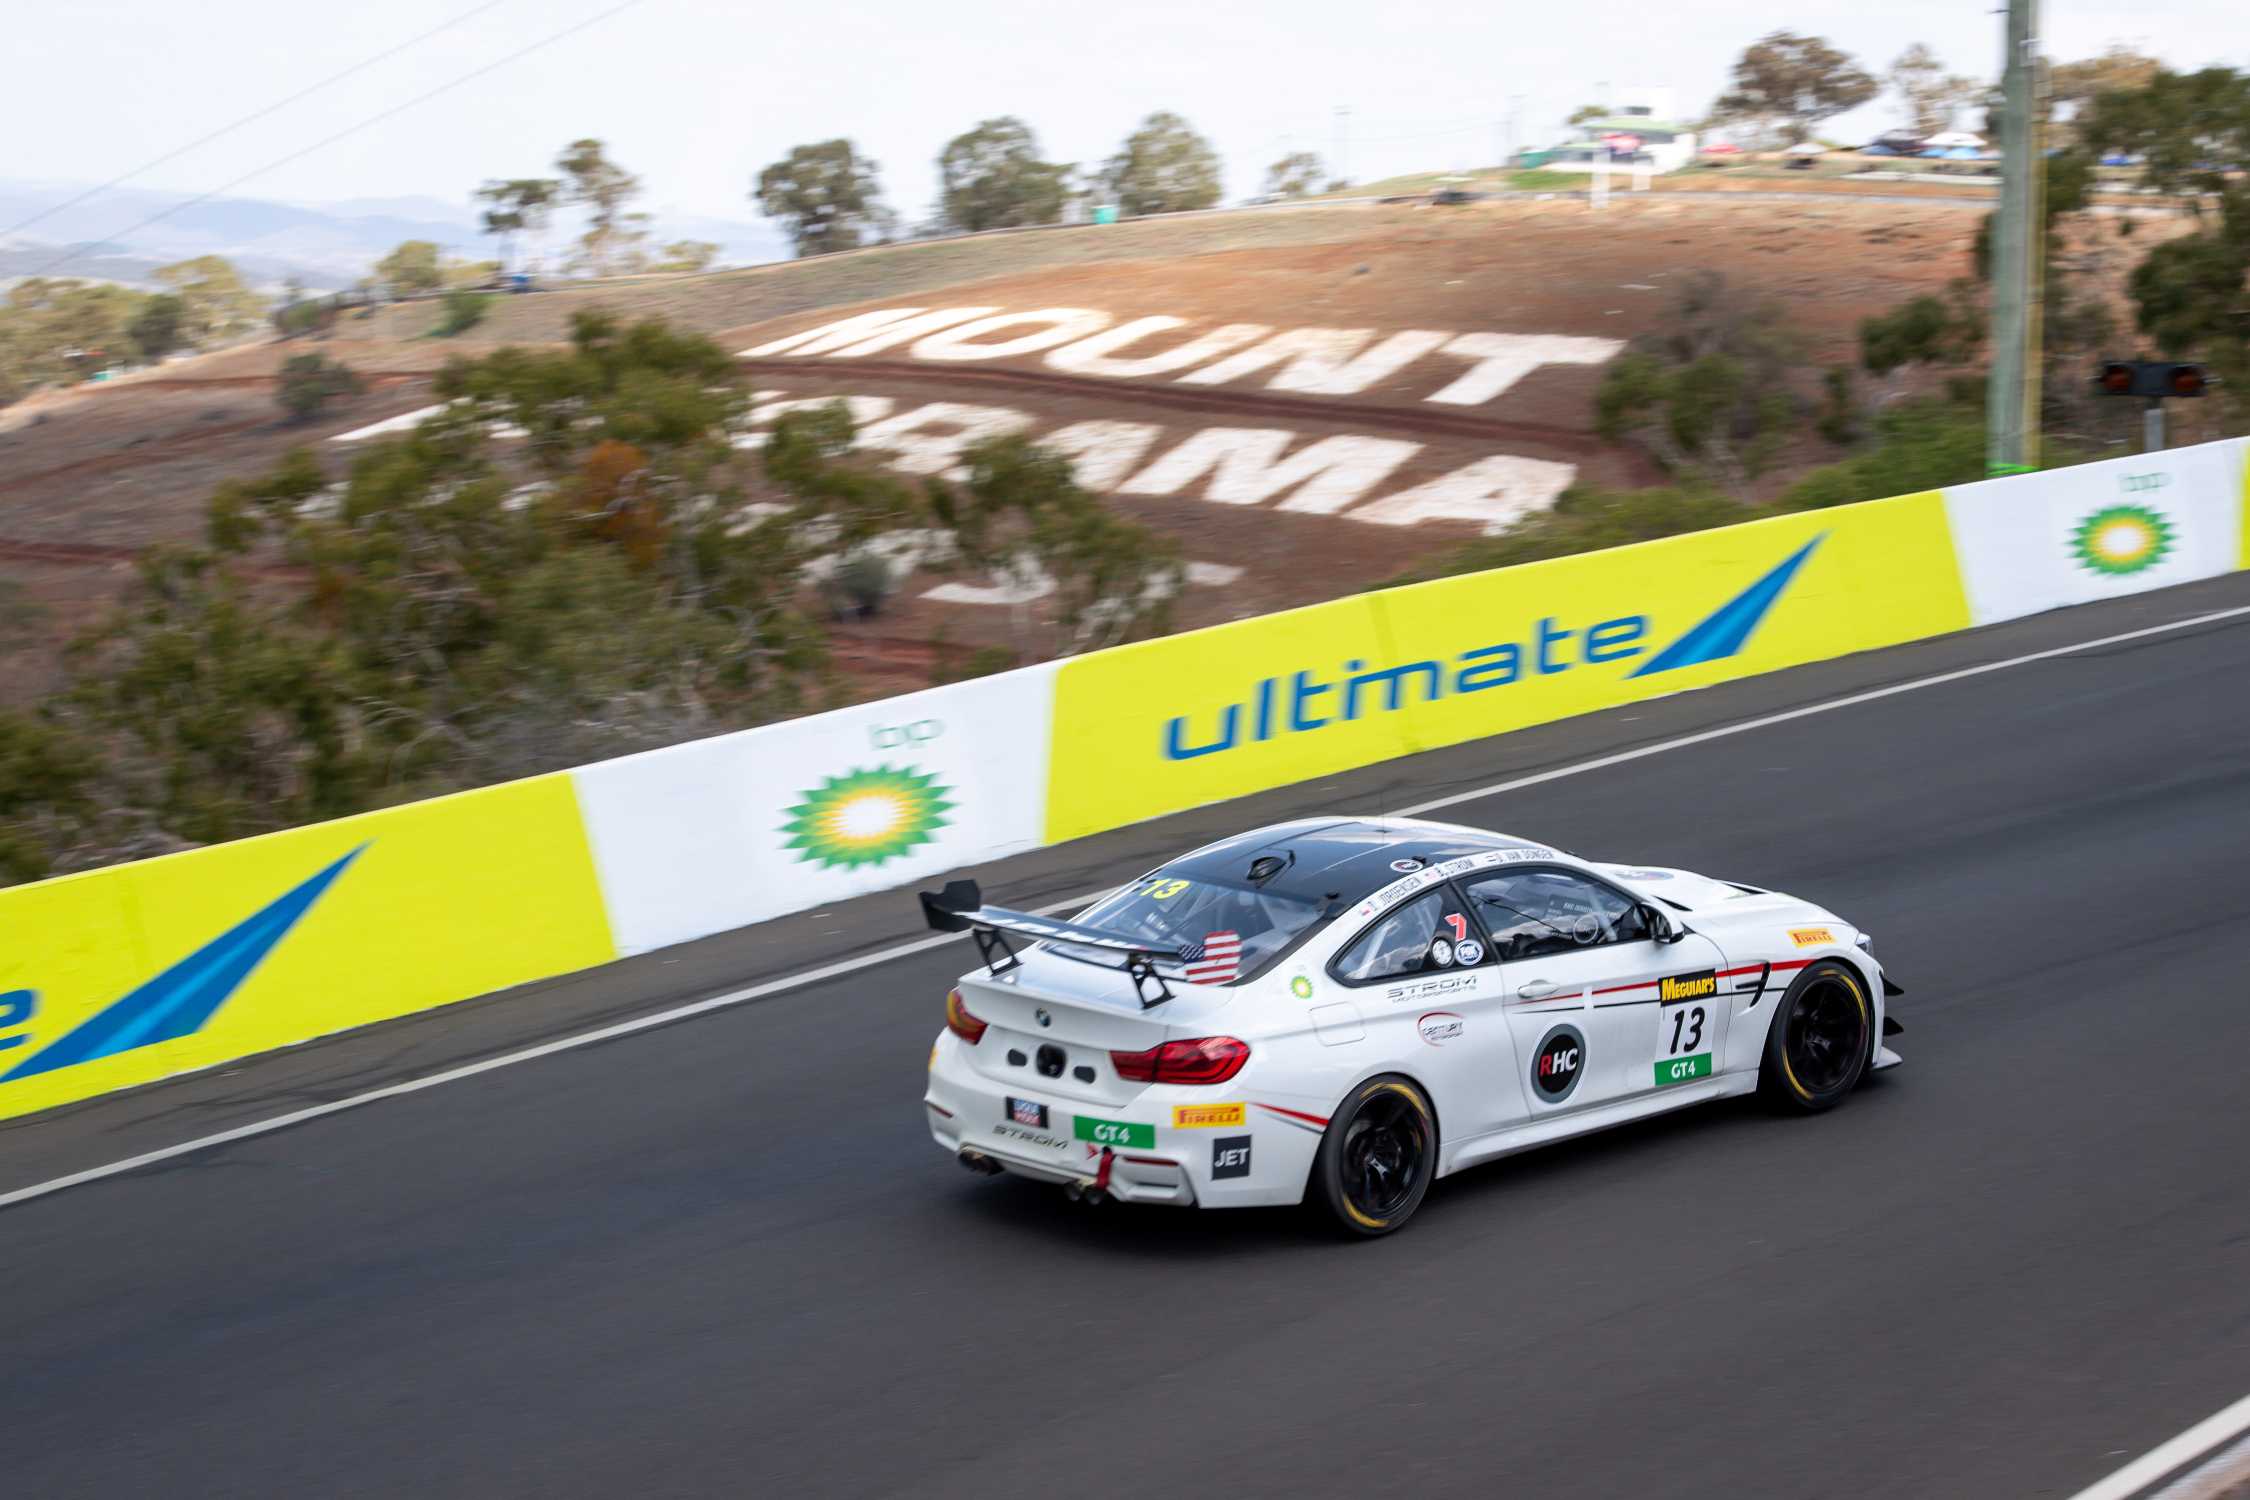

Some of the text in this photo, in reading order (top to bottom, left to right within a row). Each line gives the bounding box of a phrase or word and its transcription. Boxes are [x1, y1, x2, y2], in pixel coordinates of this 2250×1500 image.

[736, 307, 1628, 406] MOUNT
[1162, 615, 1652, 761] ultimate
[1139, 878, 1191, 900] 13
[1793, 930, 1833, 944] PIRELLI
[1387, 974, 1477, 999] STROM
[1669, 1006, 1705, 1056] 13
[1539, 1047, 1578, 1077] RHC
[1671, 1060, 1696, 1079] GT4
[1178, 1106, 1243, 1125] PIRELLI
[991, 1124, 1069, 1150] STROM
[1093, 1123, 1131, 1144] GT4
[1214, 1147, 1250, 1169] JET
